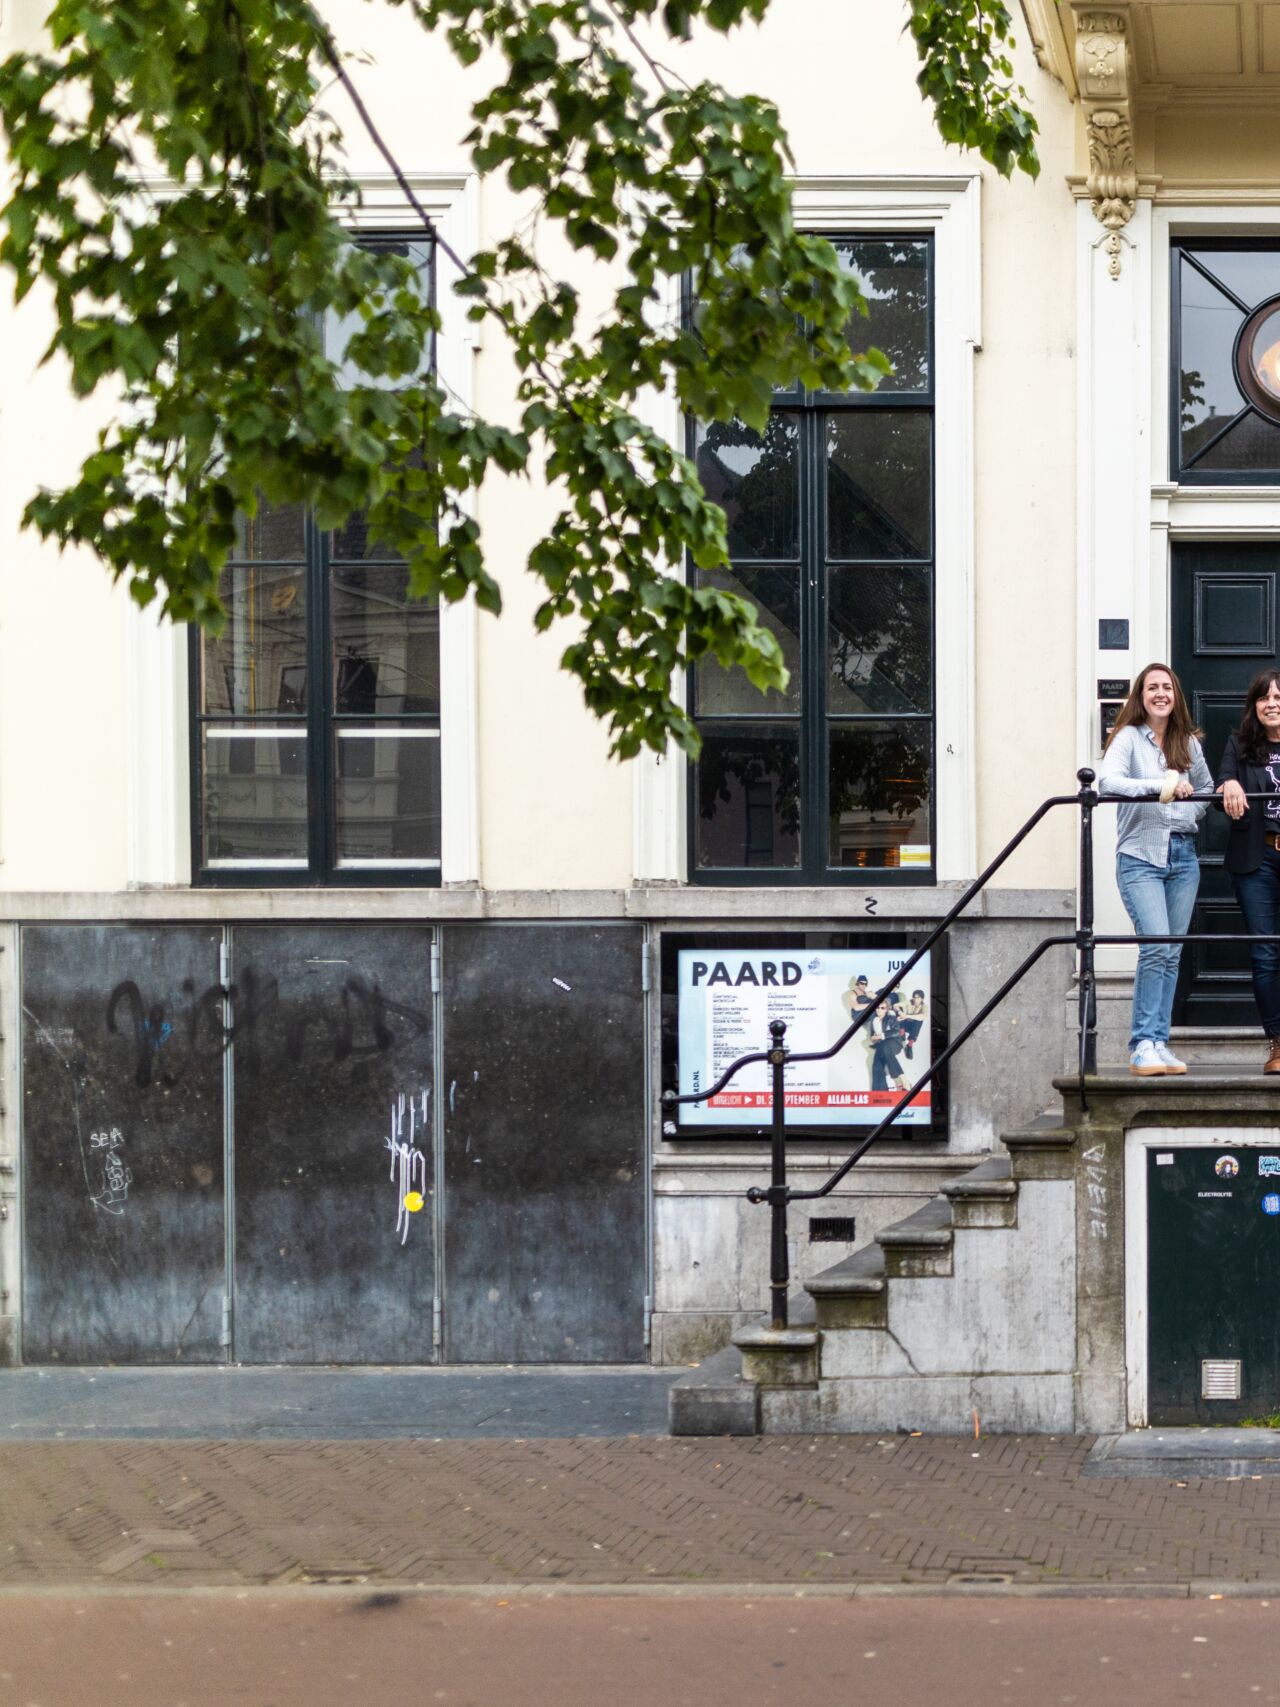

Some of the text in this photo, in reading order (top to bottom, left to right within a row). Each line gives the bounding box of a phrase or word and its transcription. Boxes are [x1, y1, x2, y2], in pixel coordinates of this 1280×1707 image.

[691, 961, 803, 987] PAARD
[756, 1094, 767, 1105] DI.
[784, 1094, 820, 1105] PTEMBER
[827, 1093, 870, 1106] ALLAH-LAS
